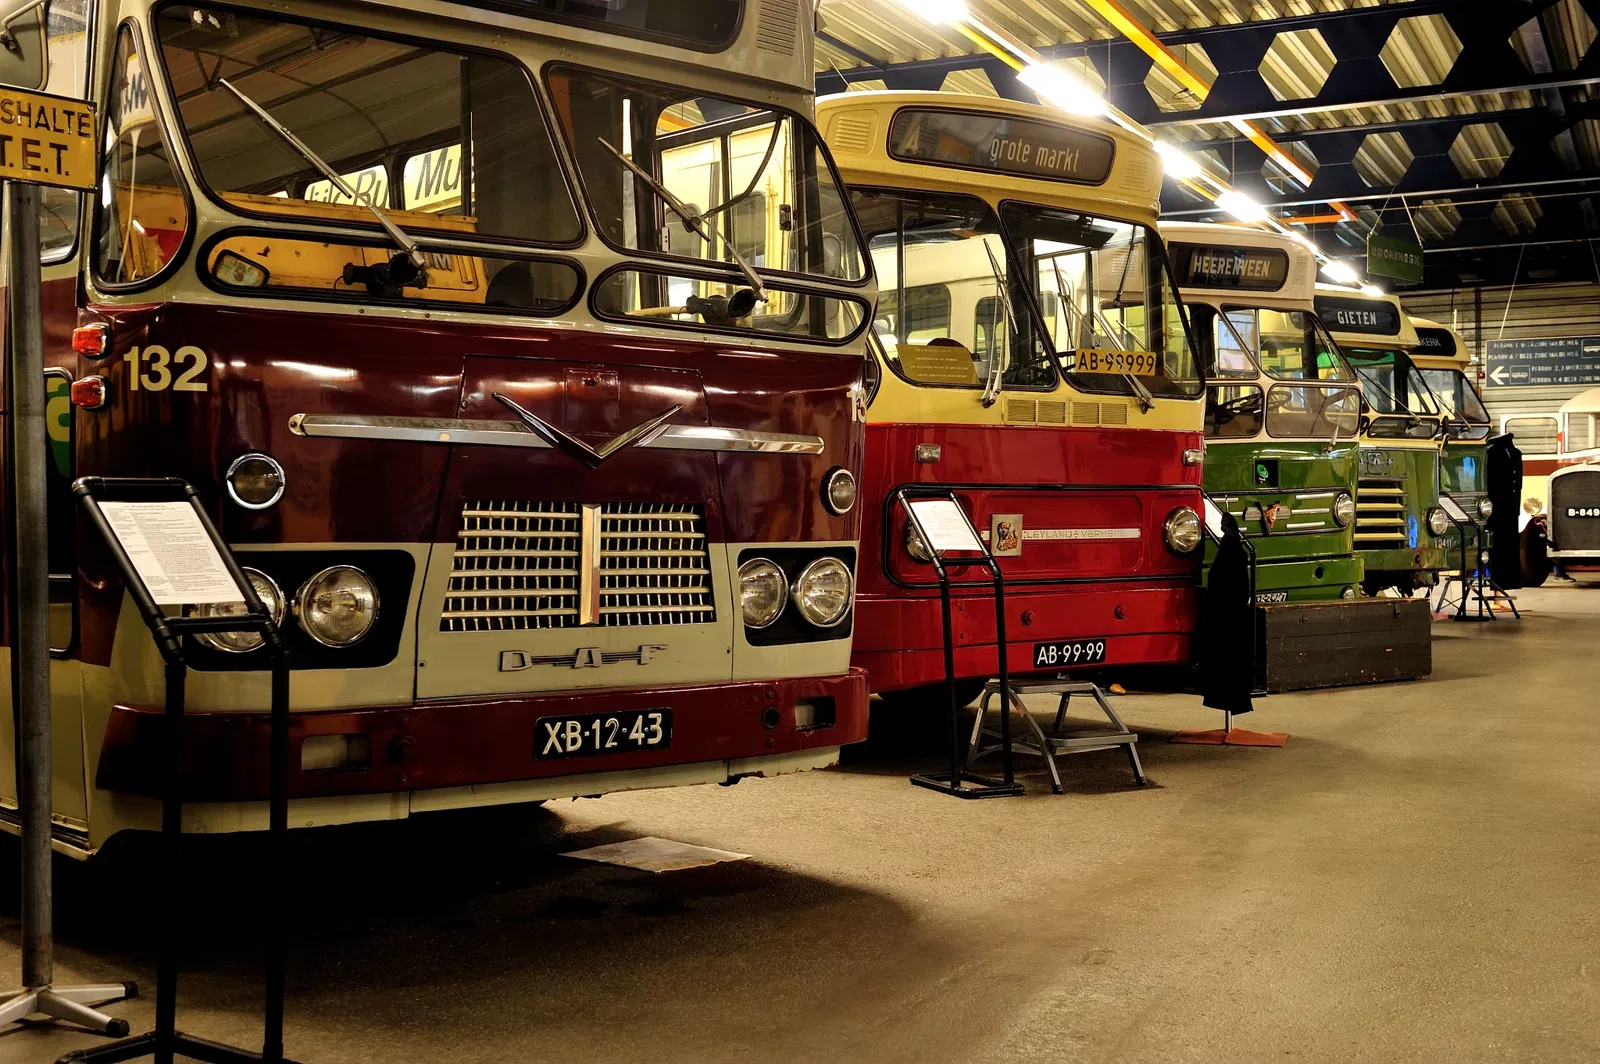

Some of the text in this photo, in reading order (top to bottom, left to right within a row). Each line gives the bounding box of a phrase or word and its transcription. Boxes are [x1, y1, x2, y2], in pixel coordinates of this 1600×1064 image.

[990, 137, 1080, 172] grote markt
[415, 147, 462, 200] Mu
[1193, 255, 1271, 277] HEERENVEEN
[1337, 311, 1377, 325] GIETEN
[123, 345, 208, 392] 132
[1078, 351, 1155, 373] AB-99999
[499, 644, 668, 672] DAF
[1036, 642, 1104, 665] AB-99-99
[542, 712, 664, 756] XB-12-43
